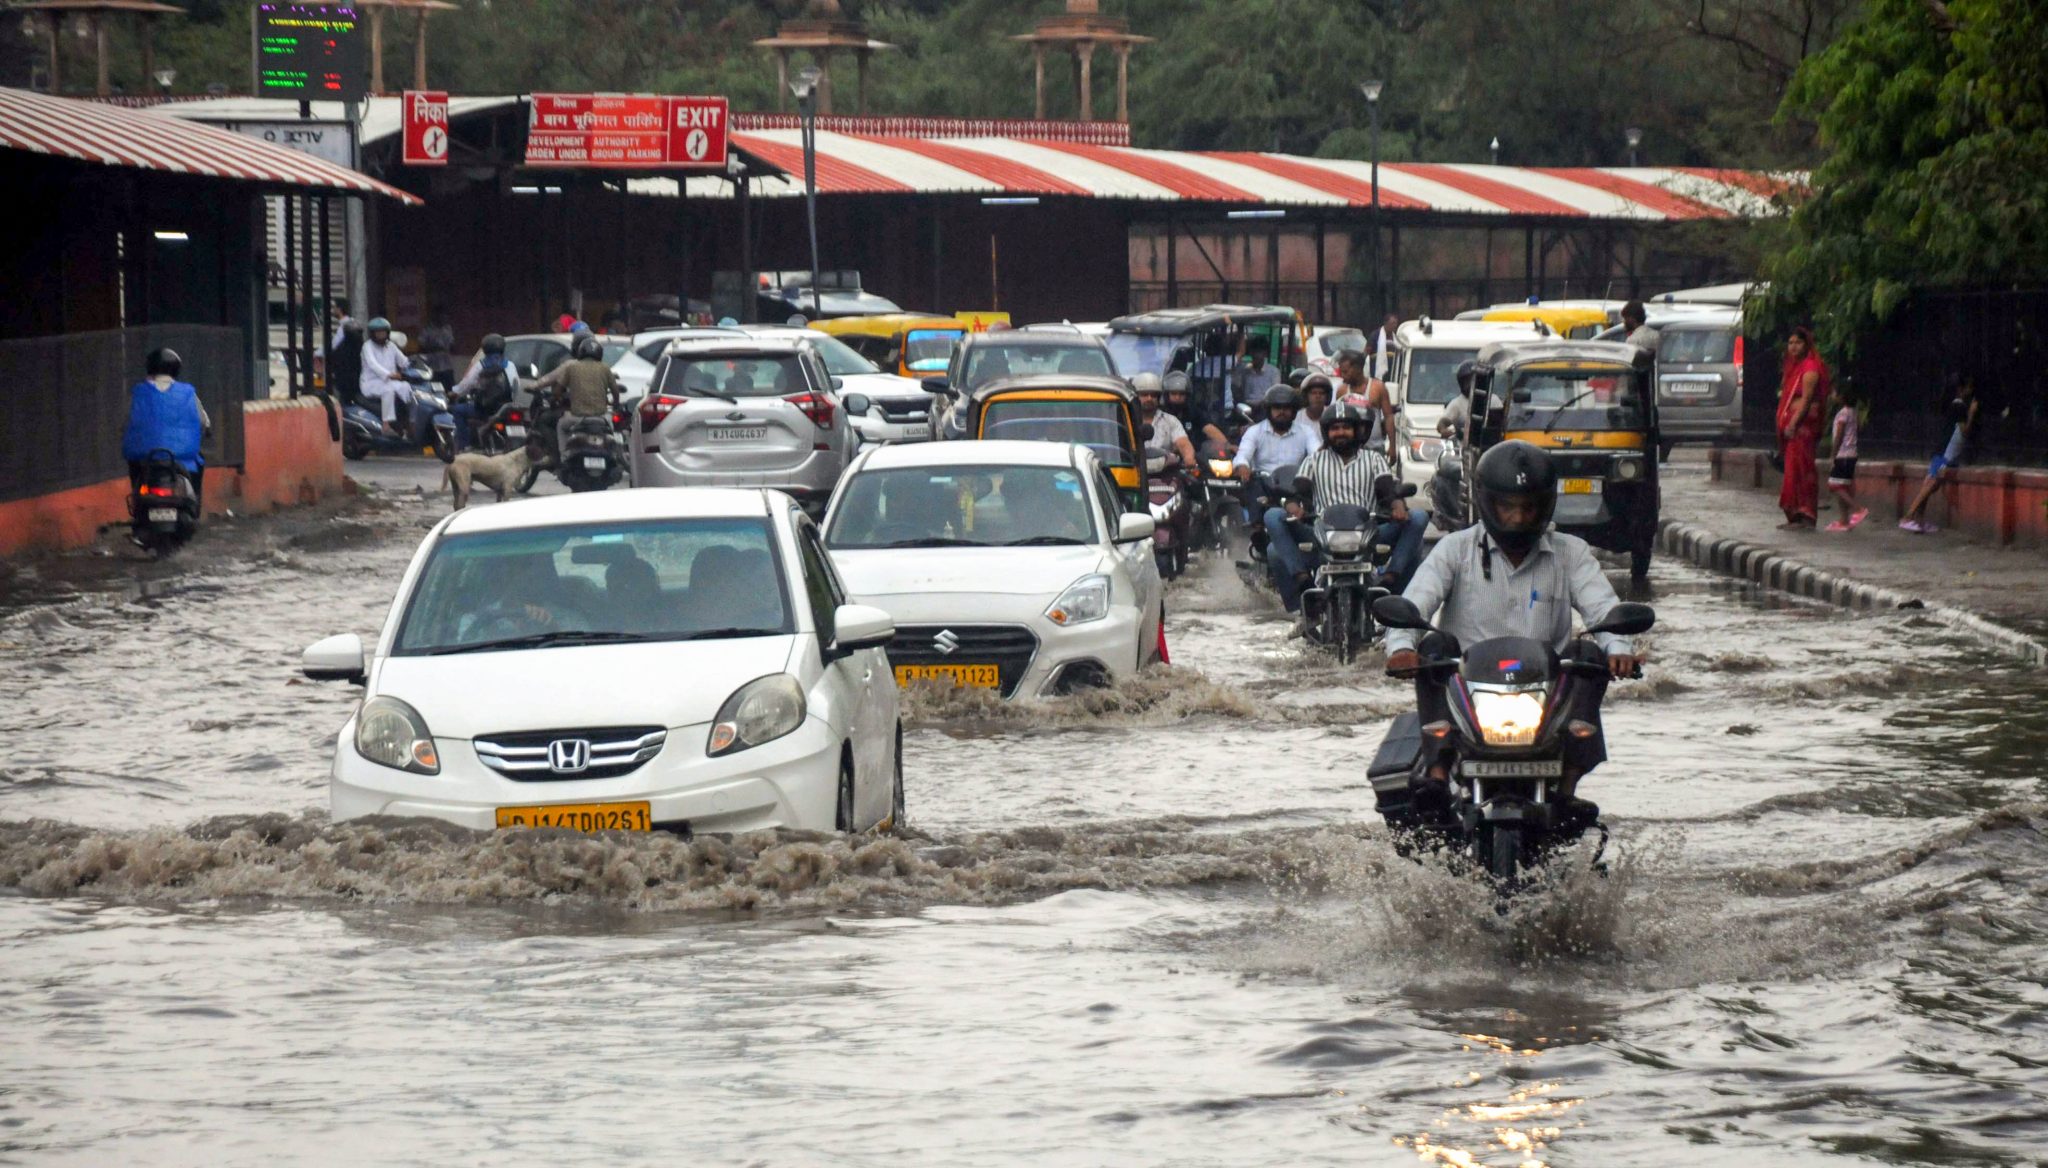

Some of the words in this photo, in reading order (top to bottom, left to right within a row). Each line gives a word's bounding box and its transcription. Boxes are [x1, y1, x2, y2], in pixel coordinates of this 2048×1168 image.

[414, 95, 447, 123] निका
[677, 106, 721, 128] EXIT
[528, 135, 585, 146] DEVELOPMENT
[593, 136, 640, 147] AUTHORITY
[526, 147, 555, 159] ARDEN
[558, 148, 587, 159] UNDER
[591, 148, 624, 159] GROUND
[627, 148, 662, 159] PARKING
